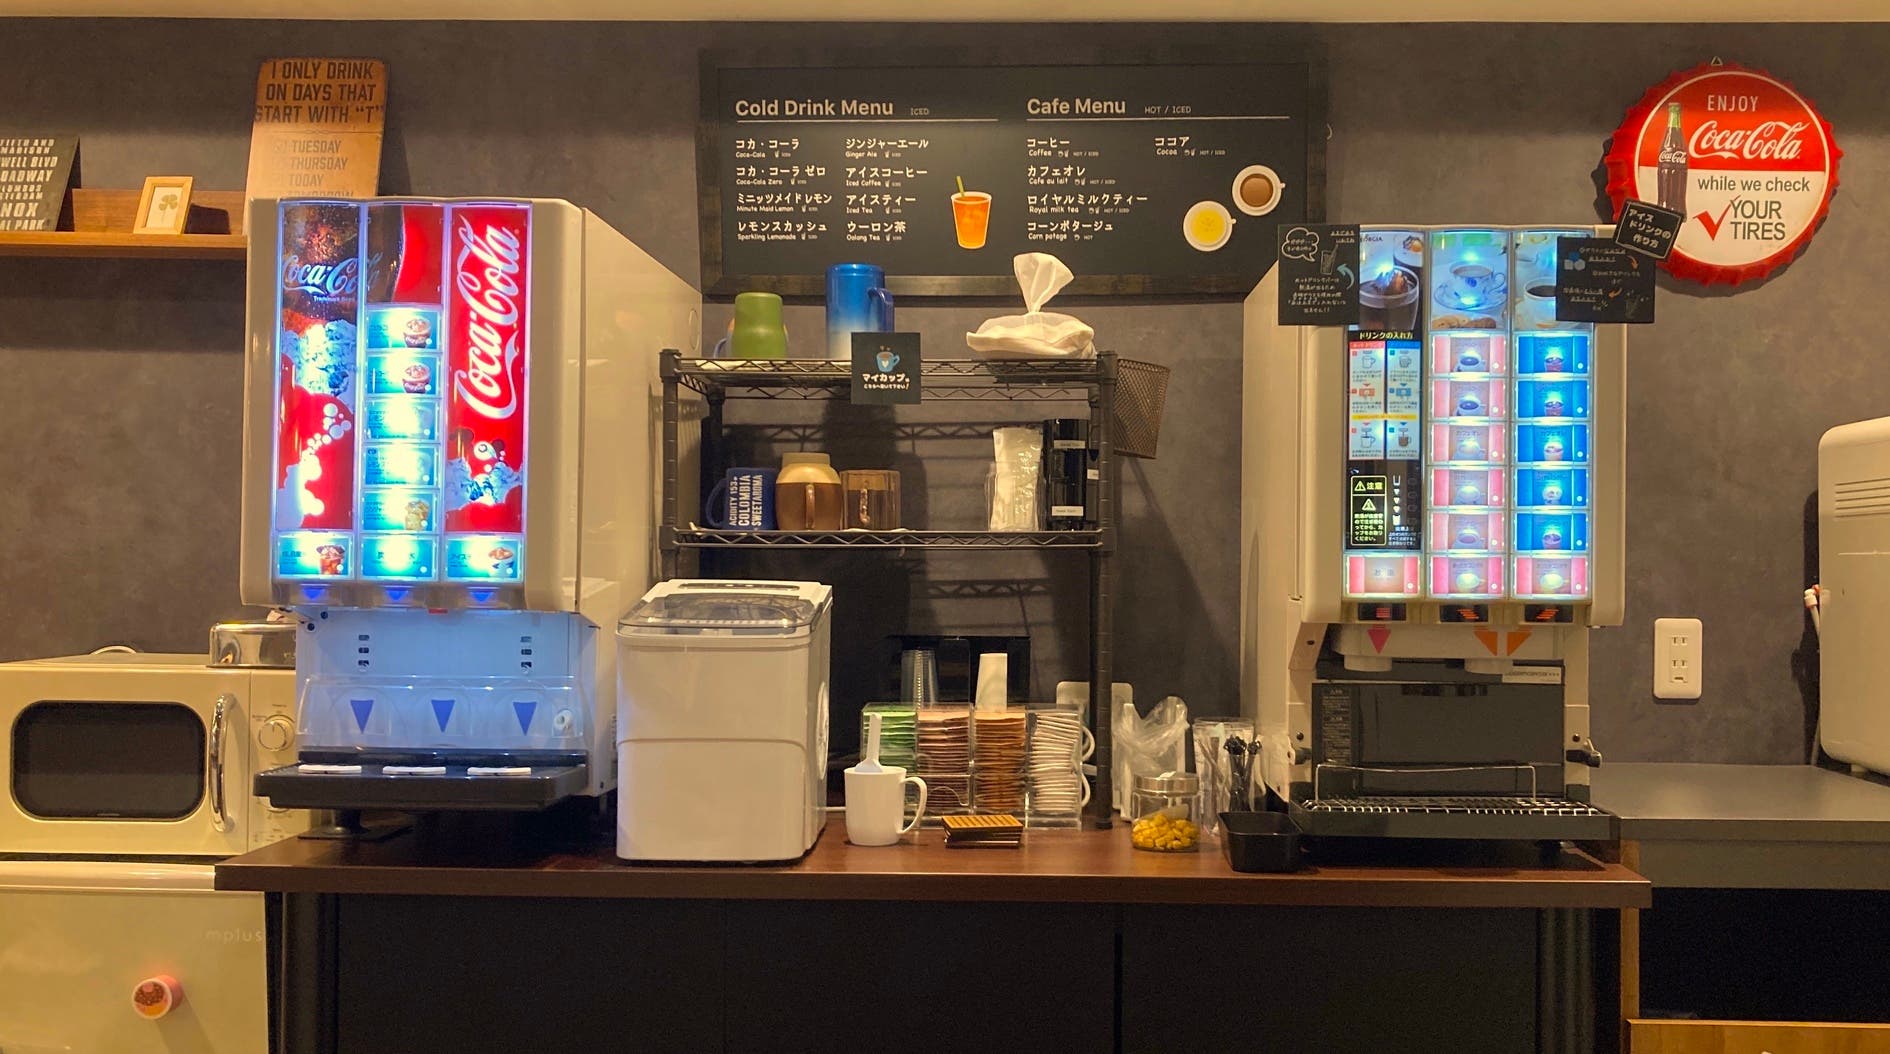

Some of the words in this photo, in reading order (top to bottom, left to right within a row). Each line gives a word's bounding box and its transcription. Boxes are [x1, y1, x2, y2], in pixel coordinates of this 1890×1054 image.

[271, 62, 276, 79] I
[282, 62, 321, 79] ONLY
[327, 62, 375, 79] DRINK
[266, 84, 287, 101] ON
[292, 84, 332, 101] DAYS
[338, 84, 377, 101] THAT
[735, 99, 779, 116] Cold
[784, 99, 835, 116] Drink
[841, 99, 894, 116] Menu
[910, 107, 929, 116] ICED
[1027, 98, 1070, 114] Cafe
[1075, 98, 1126, 114] Menu
[1144, 106, 1161, 114] HOT
[1172, 105, 1192, 114] ICED
[1708, 95, 1759, 112] ENJOY
[255, 105, 303, 122] START
[308, 105, 349, 122] WITH
[736, 138, 800, 150] コカ・コーラ
[846, 138, 929, 149] ジンジャーエール
[1027, 137, 1070, 148] コーヒー
[1155, 136, 1190, 147] ココア
[1688, 120, 1810, 160] Coca-Cola
[291, 140, 342, 154] TUESDAY
[1028, 149, 1052, 157] Coffee
[1156, 148, 1178, 156] Cocoa
[845, 151, 865, 159] Ginger
[31, 156, 58, 168] BLVD
[290, 157, 348, 170] THURSDAY
[736, 165, 800, 177] コカ・コーラ
[804, 165, 826, 176] ゼロ
[845, 166, 928, 178] アイスコーヒー
[1027, 165, 1086, 177] カフェオレ
[289, 174, 325, 186] TODAY
[1029, 177, 1045, 185] Cafe
[1056, 177, 1068, 185] lait
[1697, 176, 1736, 191] while
[1740, 180, 1762, 191] we
[1765, 177, 1810, 192] check
[846, 194, 916, 206] アイスティー
[1027, 193, 1148, 205] ロイヤルミルクティー
[1029, 206, 1048, 214] Royal
[1050, 206, 1065, 214] milk
[1067, 206, 1079, 214] tea
[1629, 208, 1654, 223] アイス
[1731, 200, 1782, 219] YOUR
[14, 219, 44, 231] PARK
[738, 220, 827, 232] レモンスカッシュ
[847, 221, 906, 233] ウーロン茶
[1027, 220, 1113, 232] コーンポタージュ
[1629, 220, 1672, 240] ドリンクの
[1730, 221, 1786, 241] TIRES
[737, 233, 766, 241] Sparkling
[1045, 233, 1067, 241] potage
[1632, 233, 1659, 249] 作り方
[454, 214, 521, 419] Coca-Cola
[1366, 482, 1383, 490] 注意
[738, 475, 751, 526] COLOMBIA
